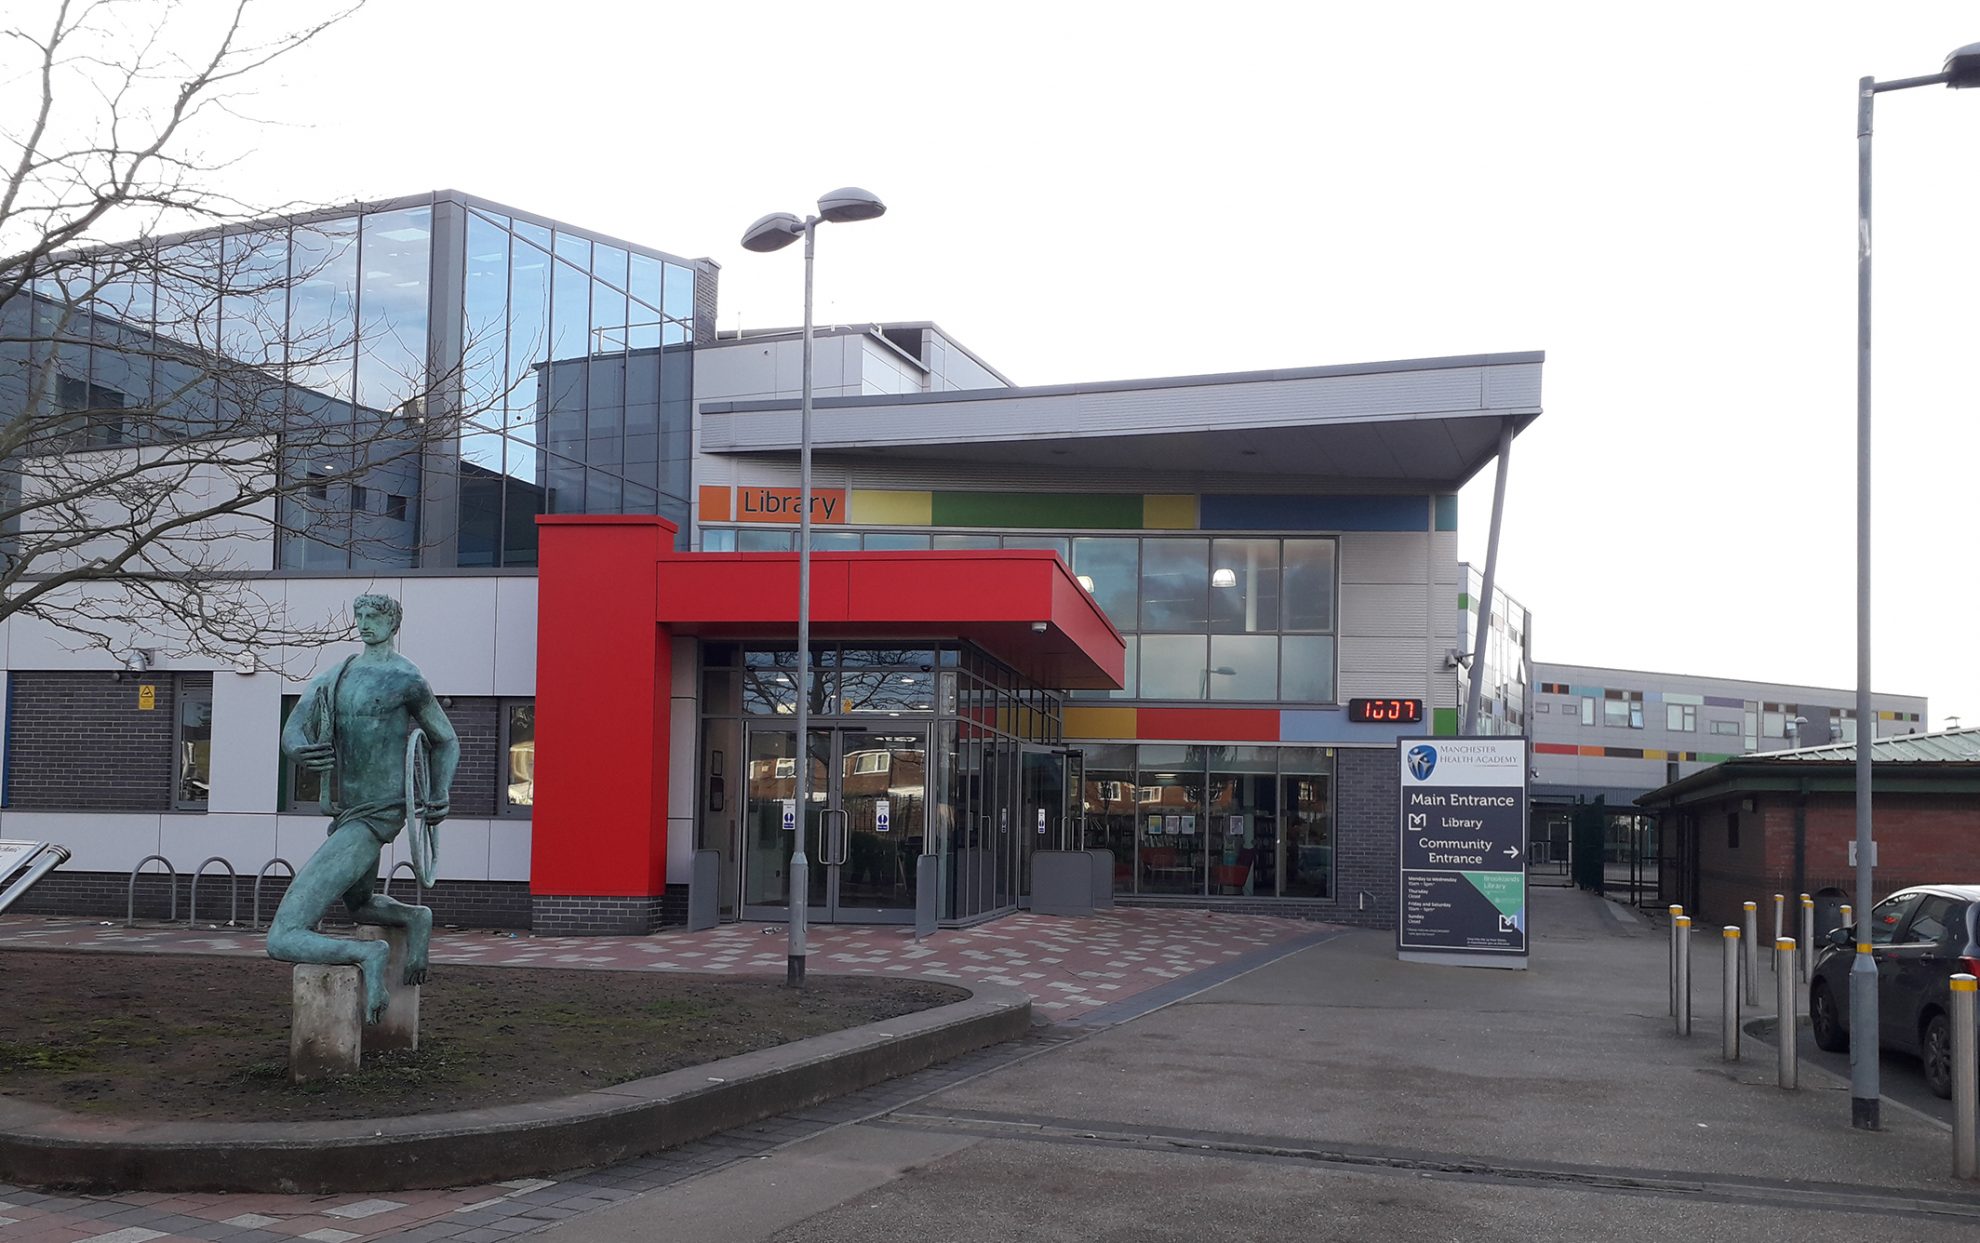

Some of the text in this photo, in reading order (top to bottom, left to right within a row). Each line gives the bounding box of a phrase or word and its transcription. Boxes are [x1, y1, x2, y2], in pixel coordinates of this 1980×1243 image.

[744, 489, 837, 519] Library
[1475, 756, 1517, 764] ACADEMY
[1410, 793, 1515, 806] Main Entrance
[1441, 817, 1483, 830] Library
[1418, 837, 1493, 852] Community
[1428, 853, 1483, 864] Entrance
